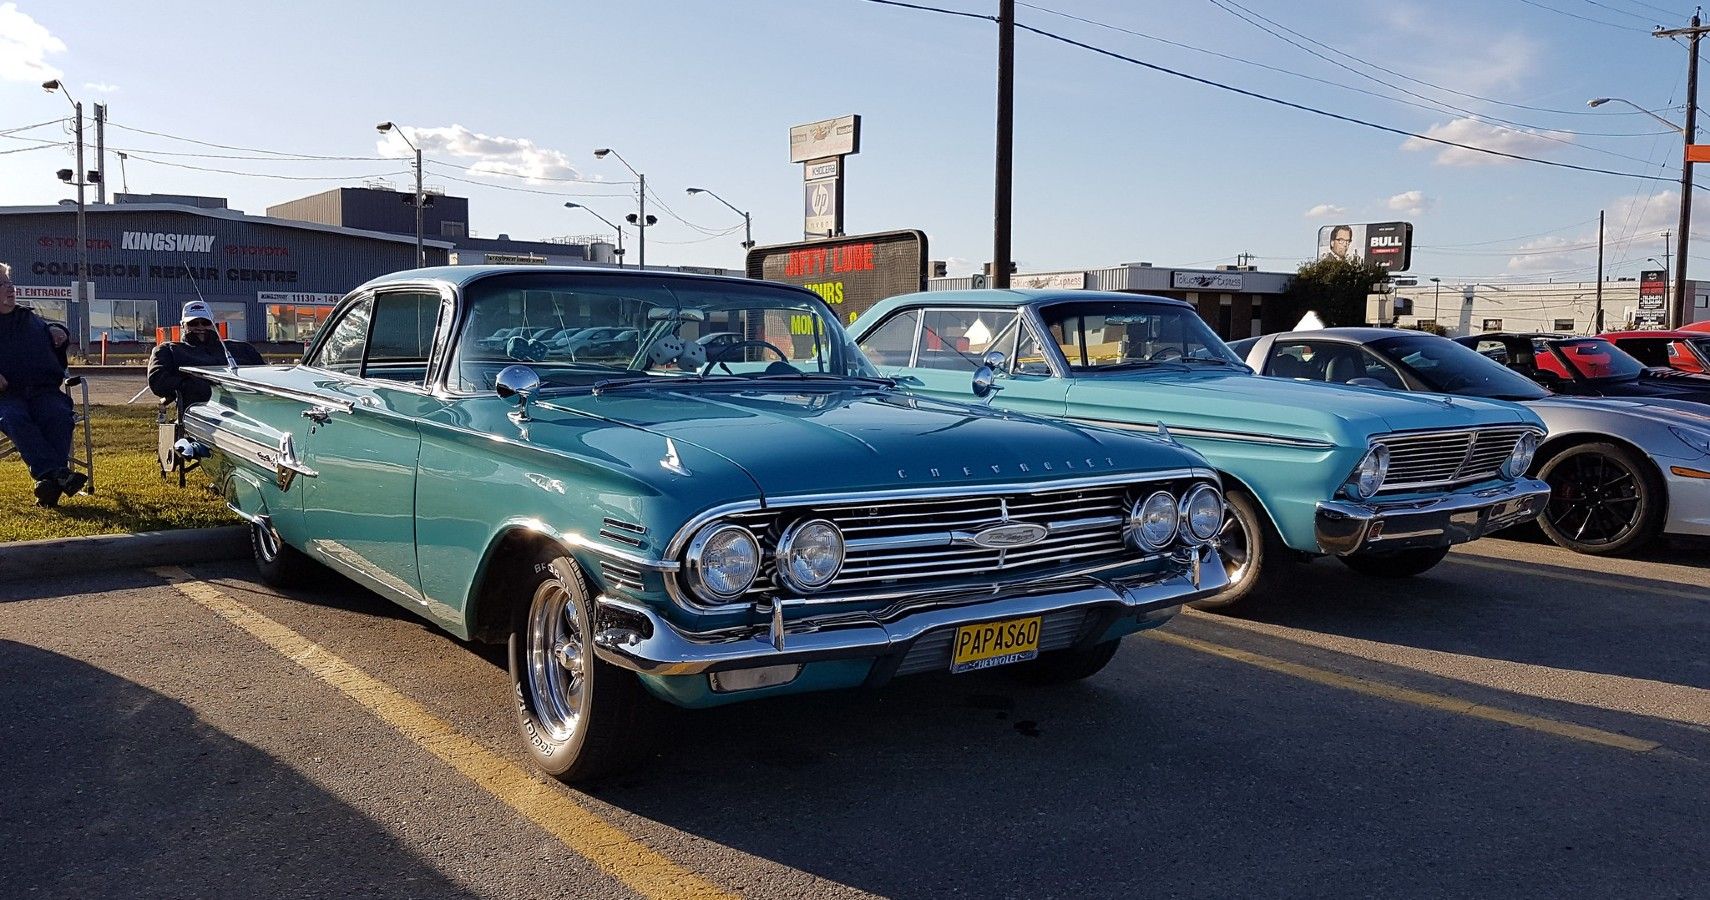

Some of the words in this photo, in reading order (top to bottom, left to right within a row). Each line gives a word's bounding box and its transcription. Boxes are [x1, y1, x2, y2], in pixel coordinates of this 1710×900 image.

[814, 184, 827, 216] hp
[121, 231, 216, 252] KINGSWAY
[1370, 236, 1402, 247] BULL
[785, 247, 827, 277] JIFFY
[832, 244, 875, 273] LUBE
[150, 266, 219, 280] REPAIR
[226, 268, 298, 282] CENTRE
[25, 288, 72, 297] ENTRANCE
[292, 294, 315, 303] 11130
[897, 457, 1115, 479] CHEVROLET
[958, 620, 1038, 657] PAPAS60
[974, 654, 1020, 670] CHEVROLET
